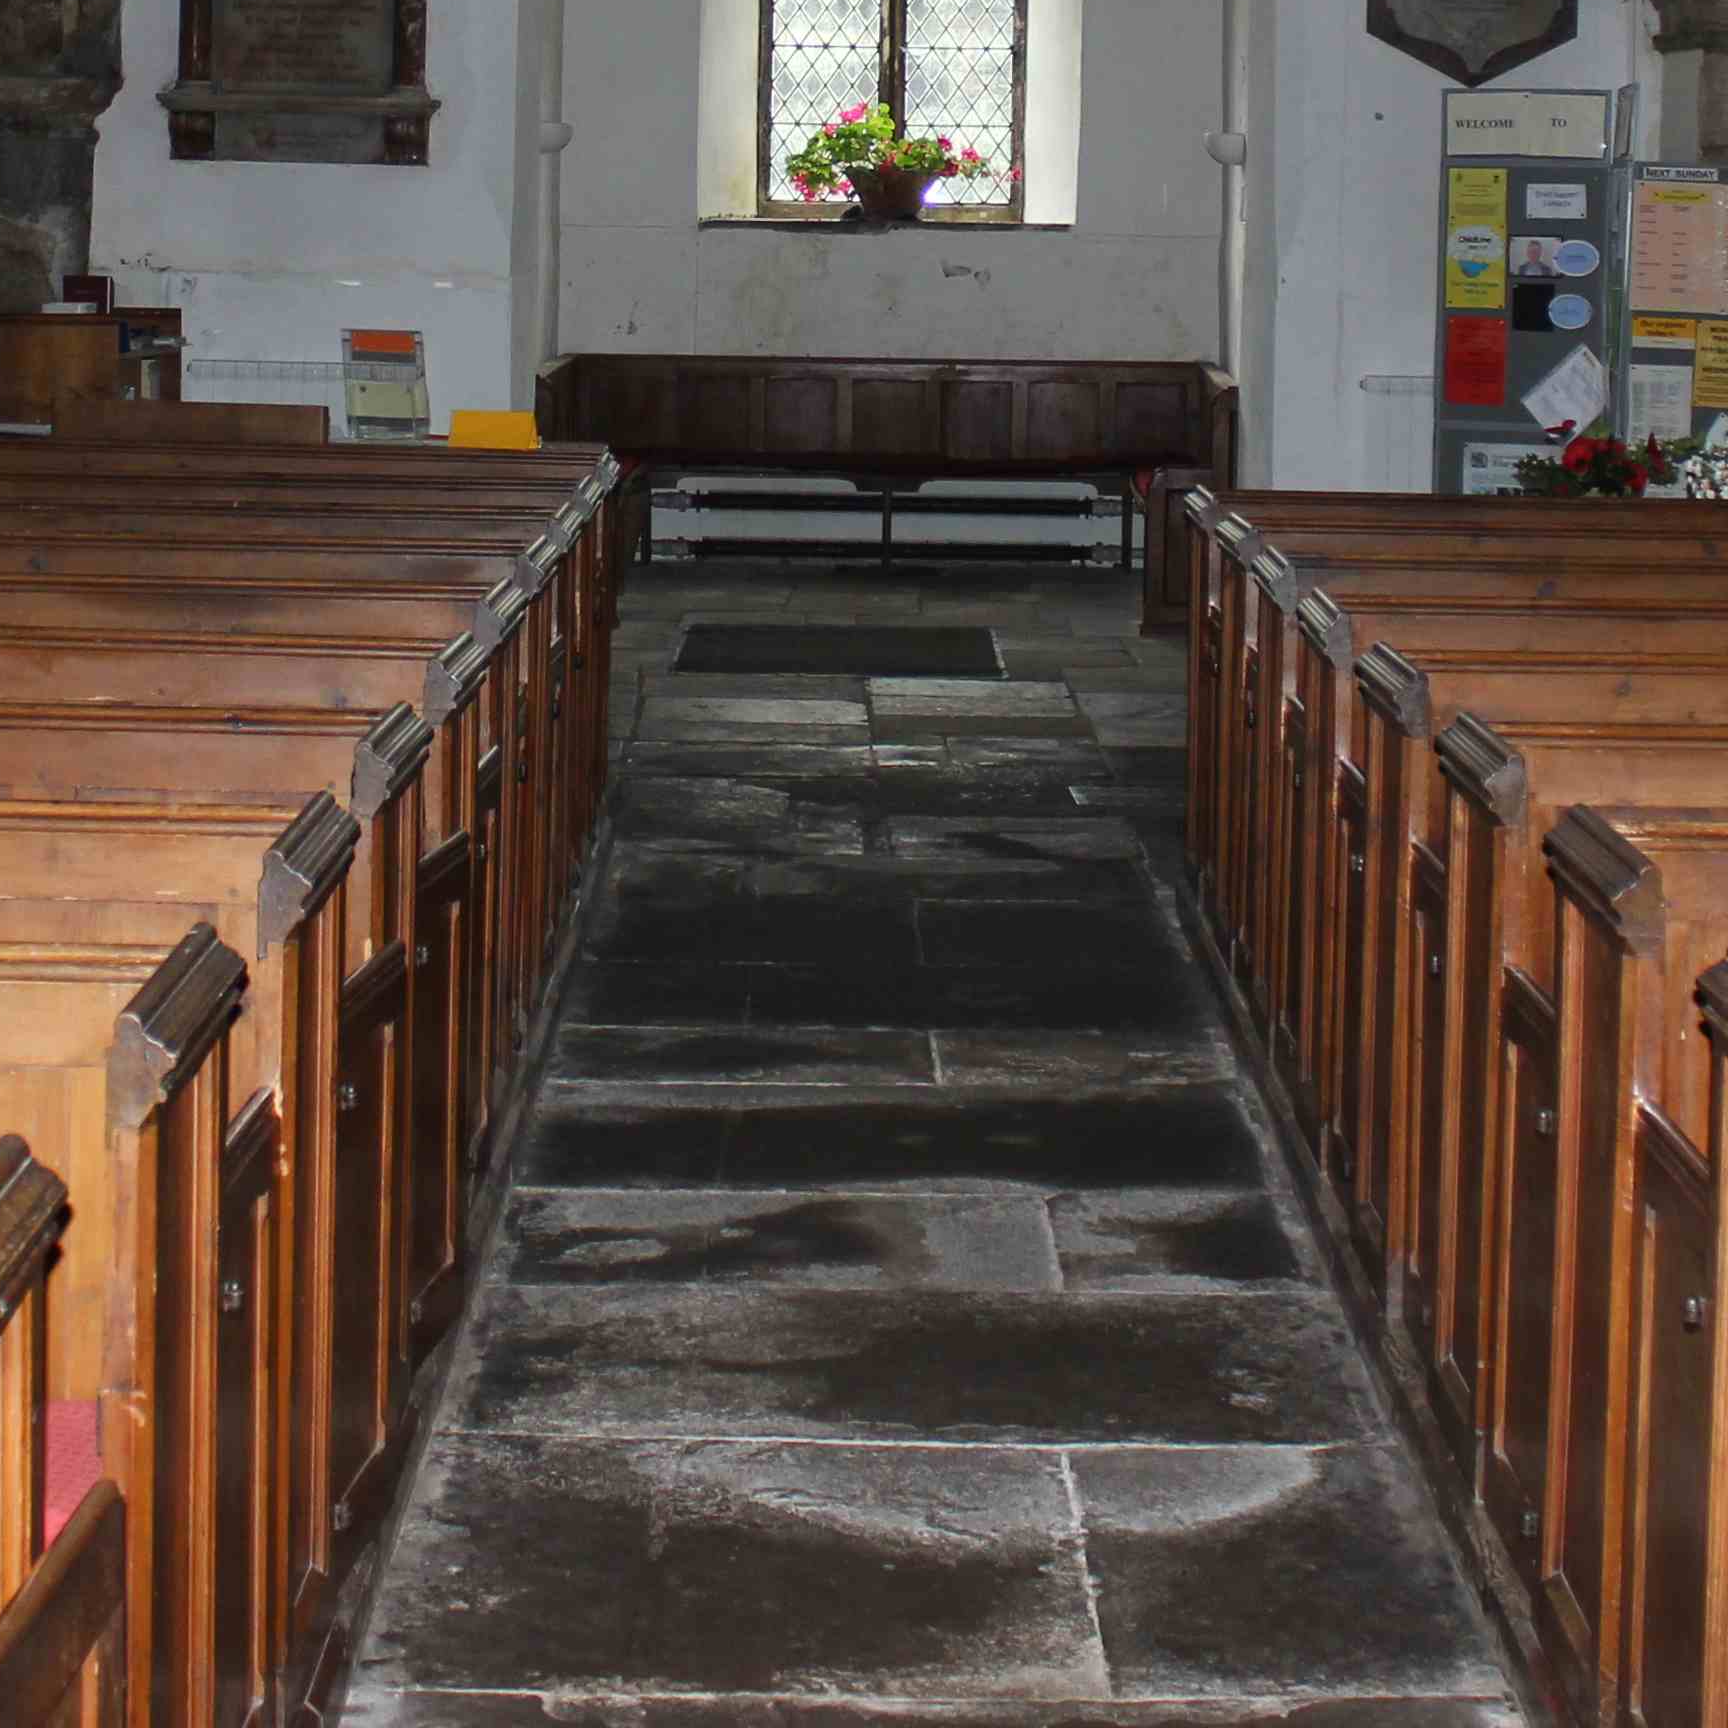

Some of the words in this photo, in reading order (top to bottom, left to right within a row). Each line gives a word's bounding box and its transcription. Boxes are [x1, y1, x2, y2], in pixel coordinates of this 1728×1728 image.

[1455, 118, 1516, 129] WELCOME
[1550, 117, 1568, 129] TO
[1647, 168, 1670, 178] NEXT
[1676, 169, 1715, 179] SUNDAY
